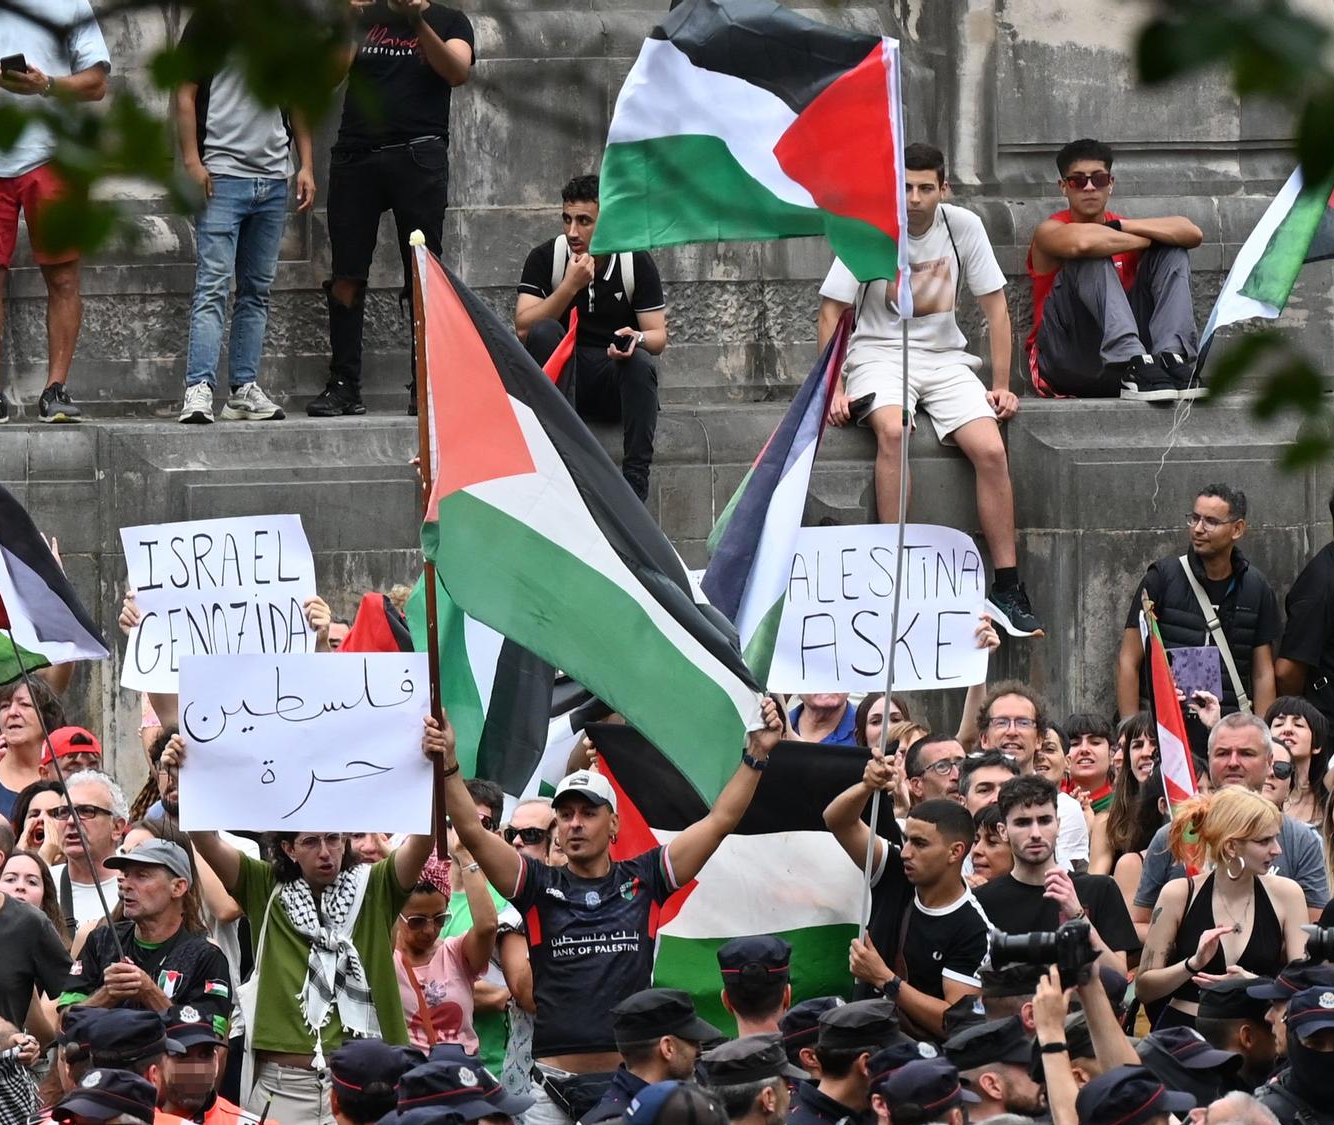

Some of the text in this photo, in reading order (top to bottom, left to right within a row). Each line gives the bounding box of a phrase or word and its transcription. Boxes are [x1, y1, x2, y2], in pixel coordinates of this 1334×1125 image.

[137, 529, 300, 592] ISRAEL
[800, 610, 971, 684] ASKE
[183, 657, 415, 743] فلسطين
[260, 759, 395, 819] حرة
[551, 934, 607, 947] فلسطين
[553, 943, 639, 958] BANK OF PALESTINE
